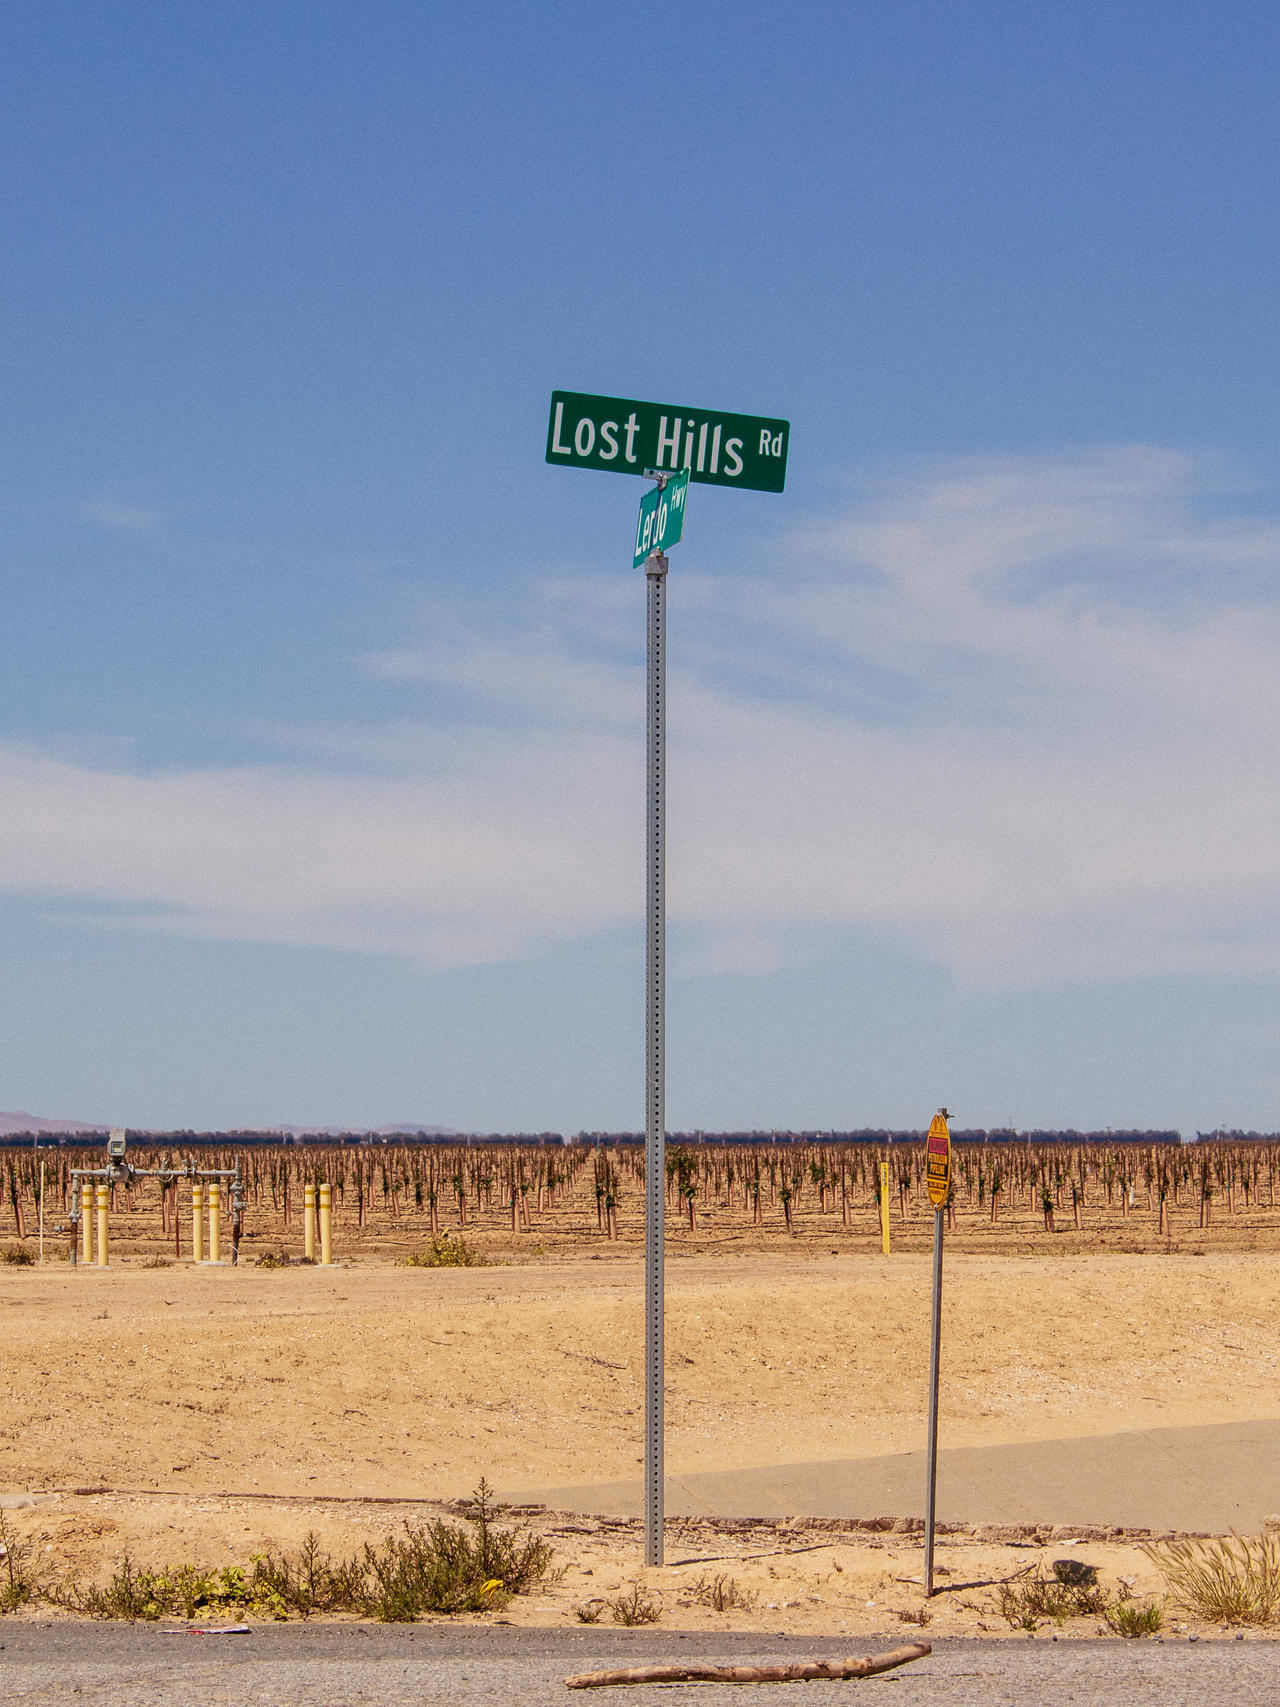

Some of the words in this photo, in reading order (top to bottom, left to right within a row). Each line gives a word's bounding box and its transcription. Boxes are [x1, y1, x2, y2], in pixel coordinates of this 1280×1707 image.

[552, 402, 640, 463] Lost
[656, 416, 743, 476] Hills
[759, 429, 783, 457] Rd
[635, 495, 667, 557] Lerdo
[670, 485, 687, 512] Hwy
